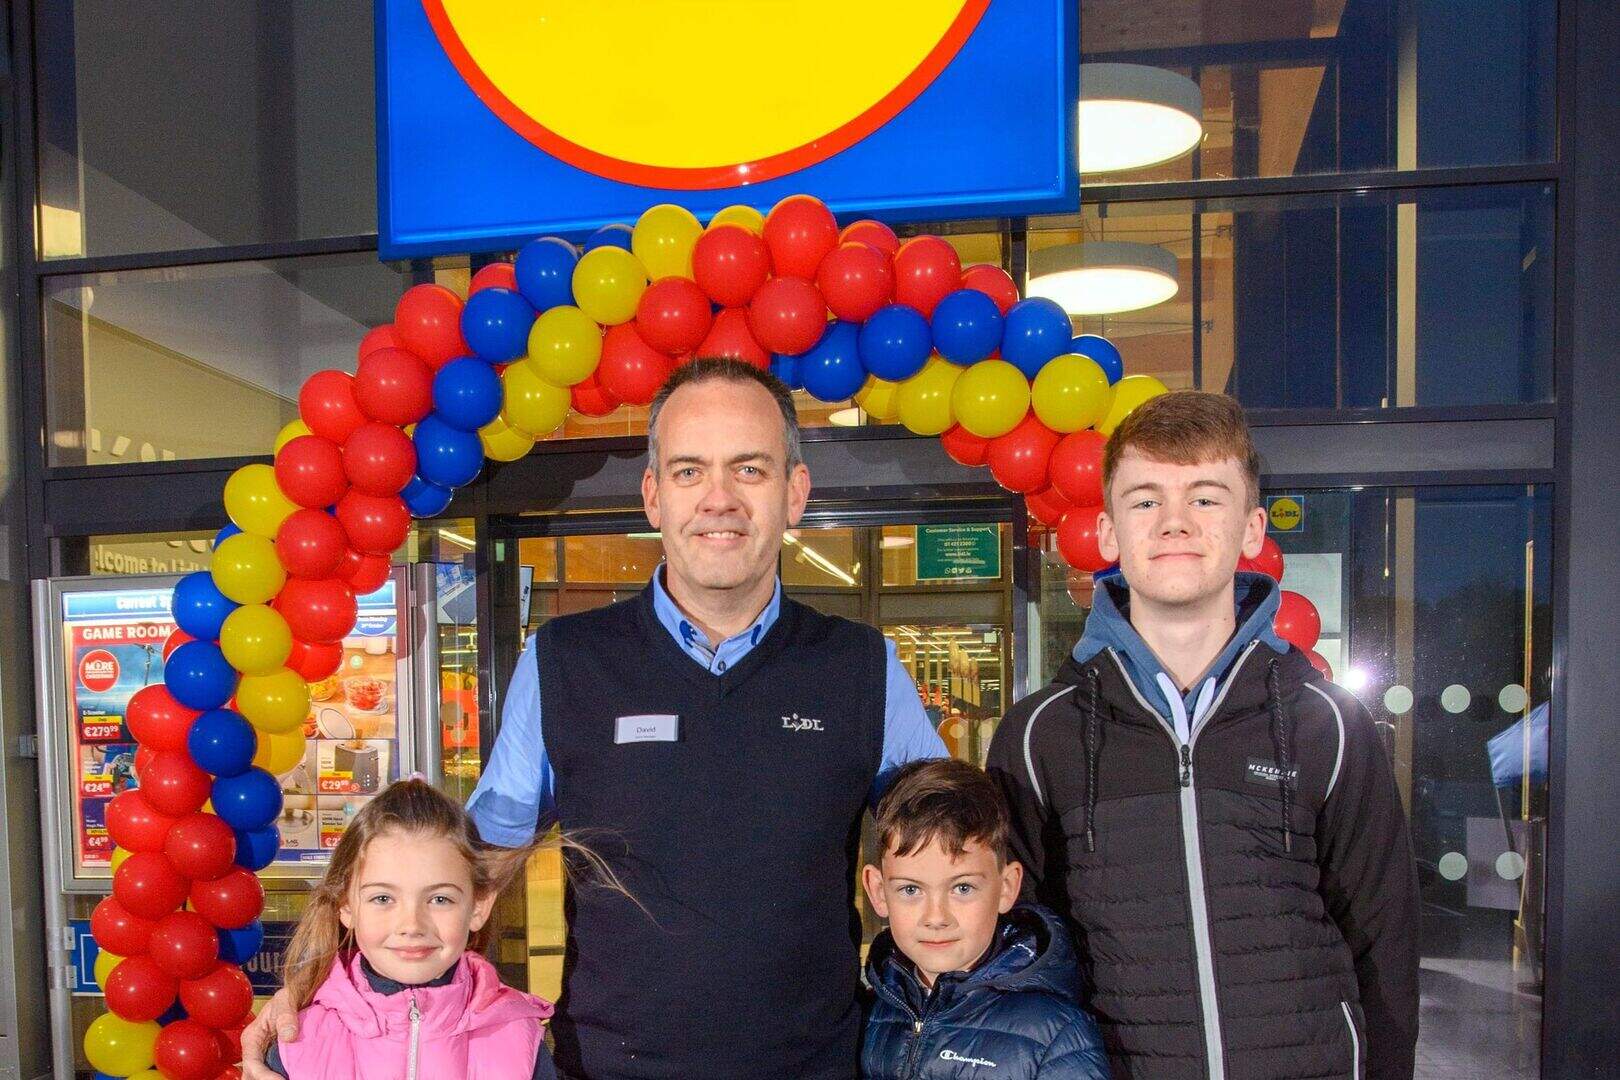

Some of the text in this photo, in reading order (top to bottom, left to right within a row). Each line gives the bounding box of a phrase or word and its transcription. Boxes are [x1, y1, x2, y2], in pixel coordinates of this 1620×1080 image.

[83, 625, 170, 640] GAME ROOM
[636, 726, 656, 734] David
[1248, 763, 1298, 778] MCKENIE
[940, 1049, 997, 1068] Champion
